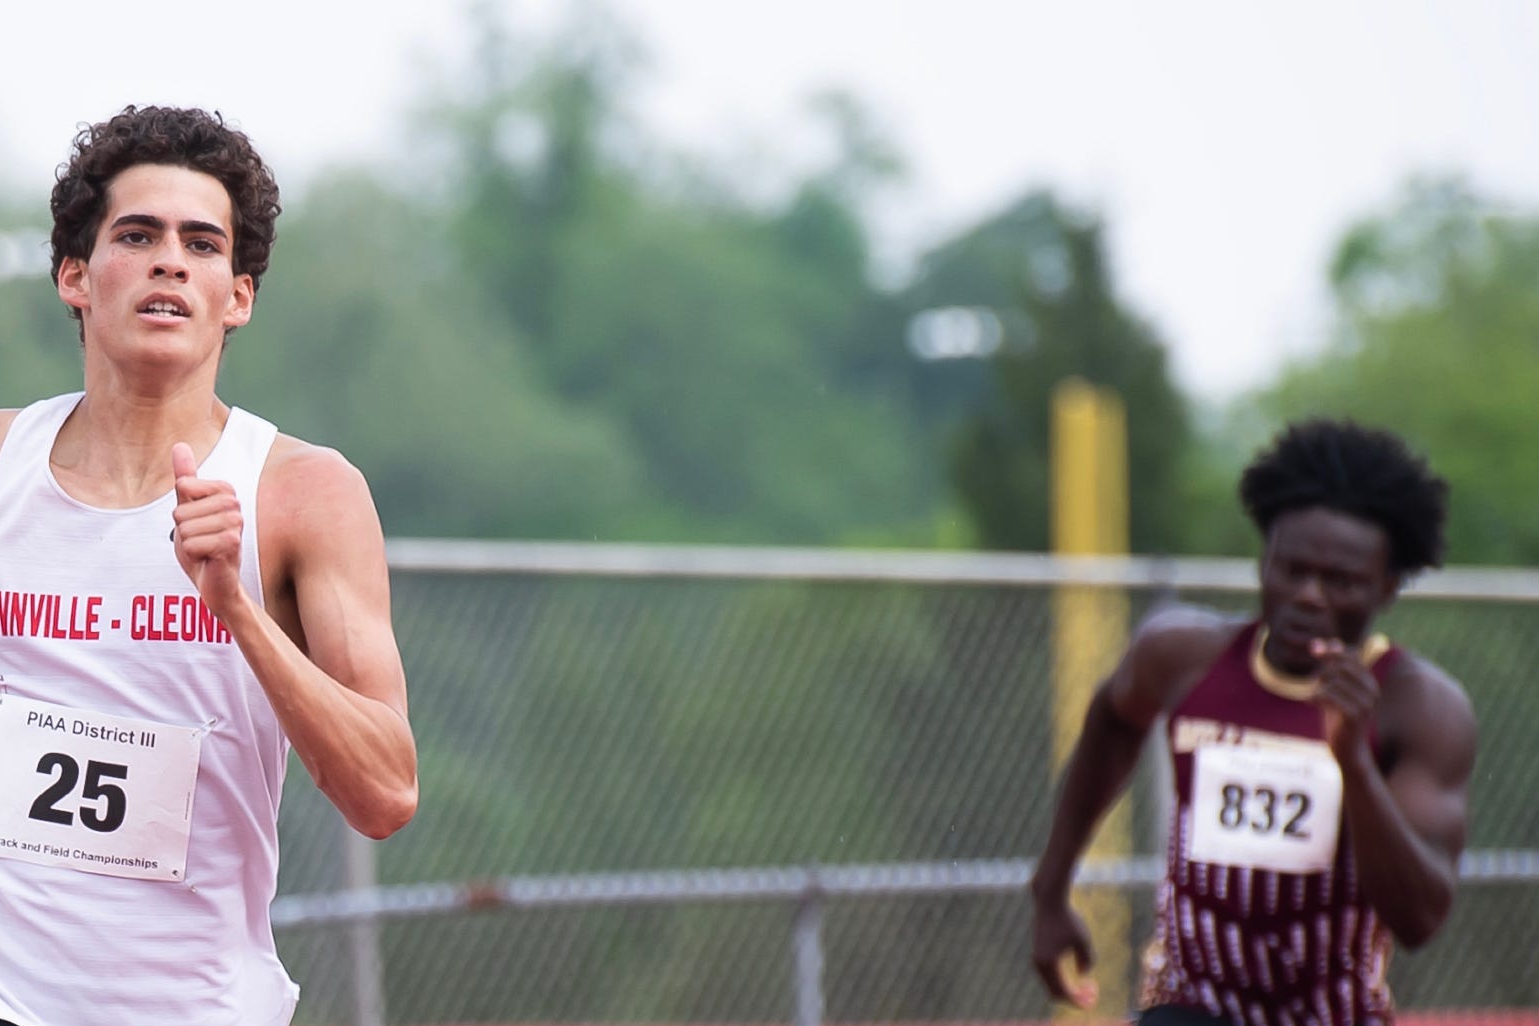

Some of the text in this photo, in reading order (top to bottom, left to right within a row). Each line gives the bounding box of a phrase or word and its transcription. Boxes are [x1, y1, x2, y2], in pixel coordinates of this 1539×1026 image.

[26, 711, 156, 748] PIAA District III
[28, 752, 128, 833] 25
[1219, 783, 1311, 838] 832
[21, 842, 40, 853] and
[43, 844, 69, 858] Field
[73, 850, 158, 870] Championships
